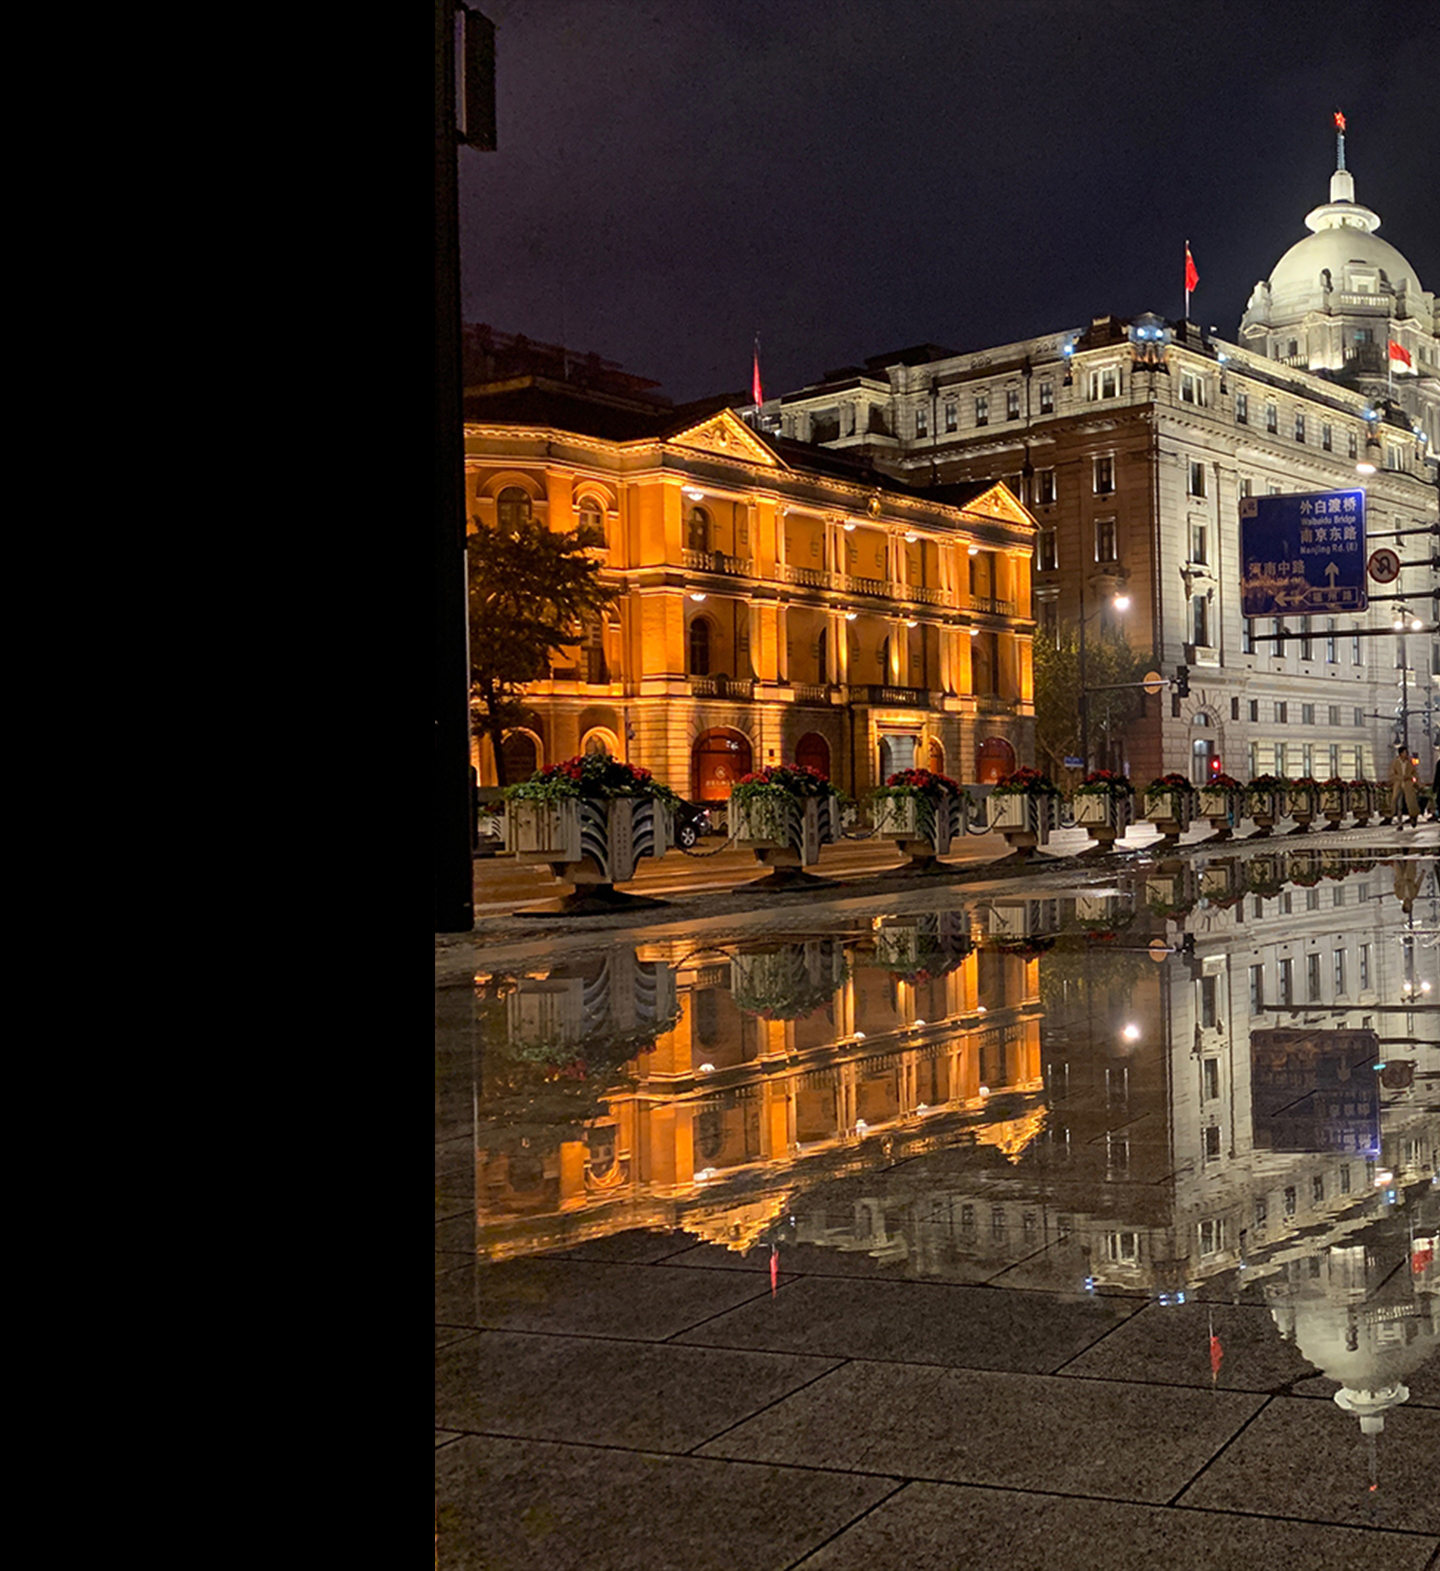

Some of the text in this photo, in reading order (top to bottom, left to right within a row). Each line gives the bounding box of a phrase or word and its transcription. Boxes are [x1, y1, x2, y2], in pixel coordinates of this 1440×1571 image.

[1300, 497, 1357, 515] 外白渡桥
[1334, 514, 1357, 525] Bridge
[1300, 526, 1358, 544] 南京东路
[1248, 560, 1305, 576] 河南中路
